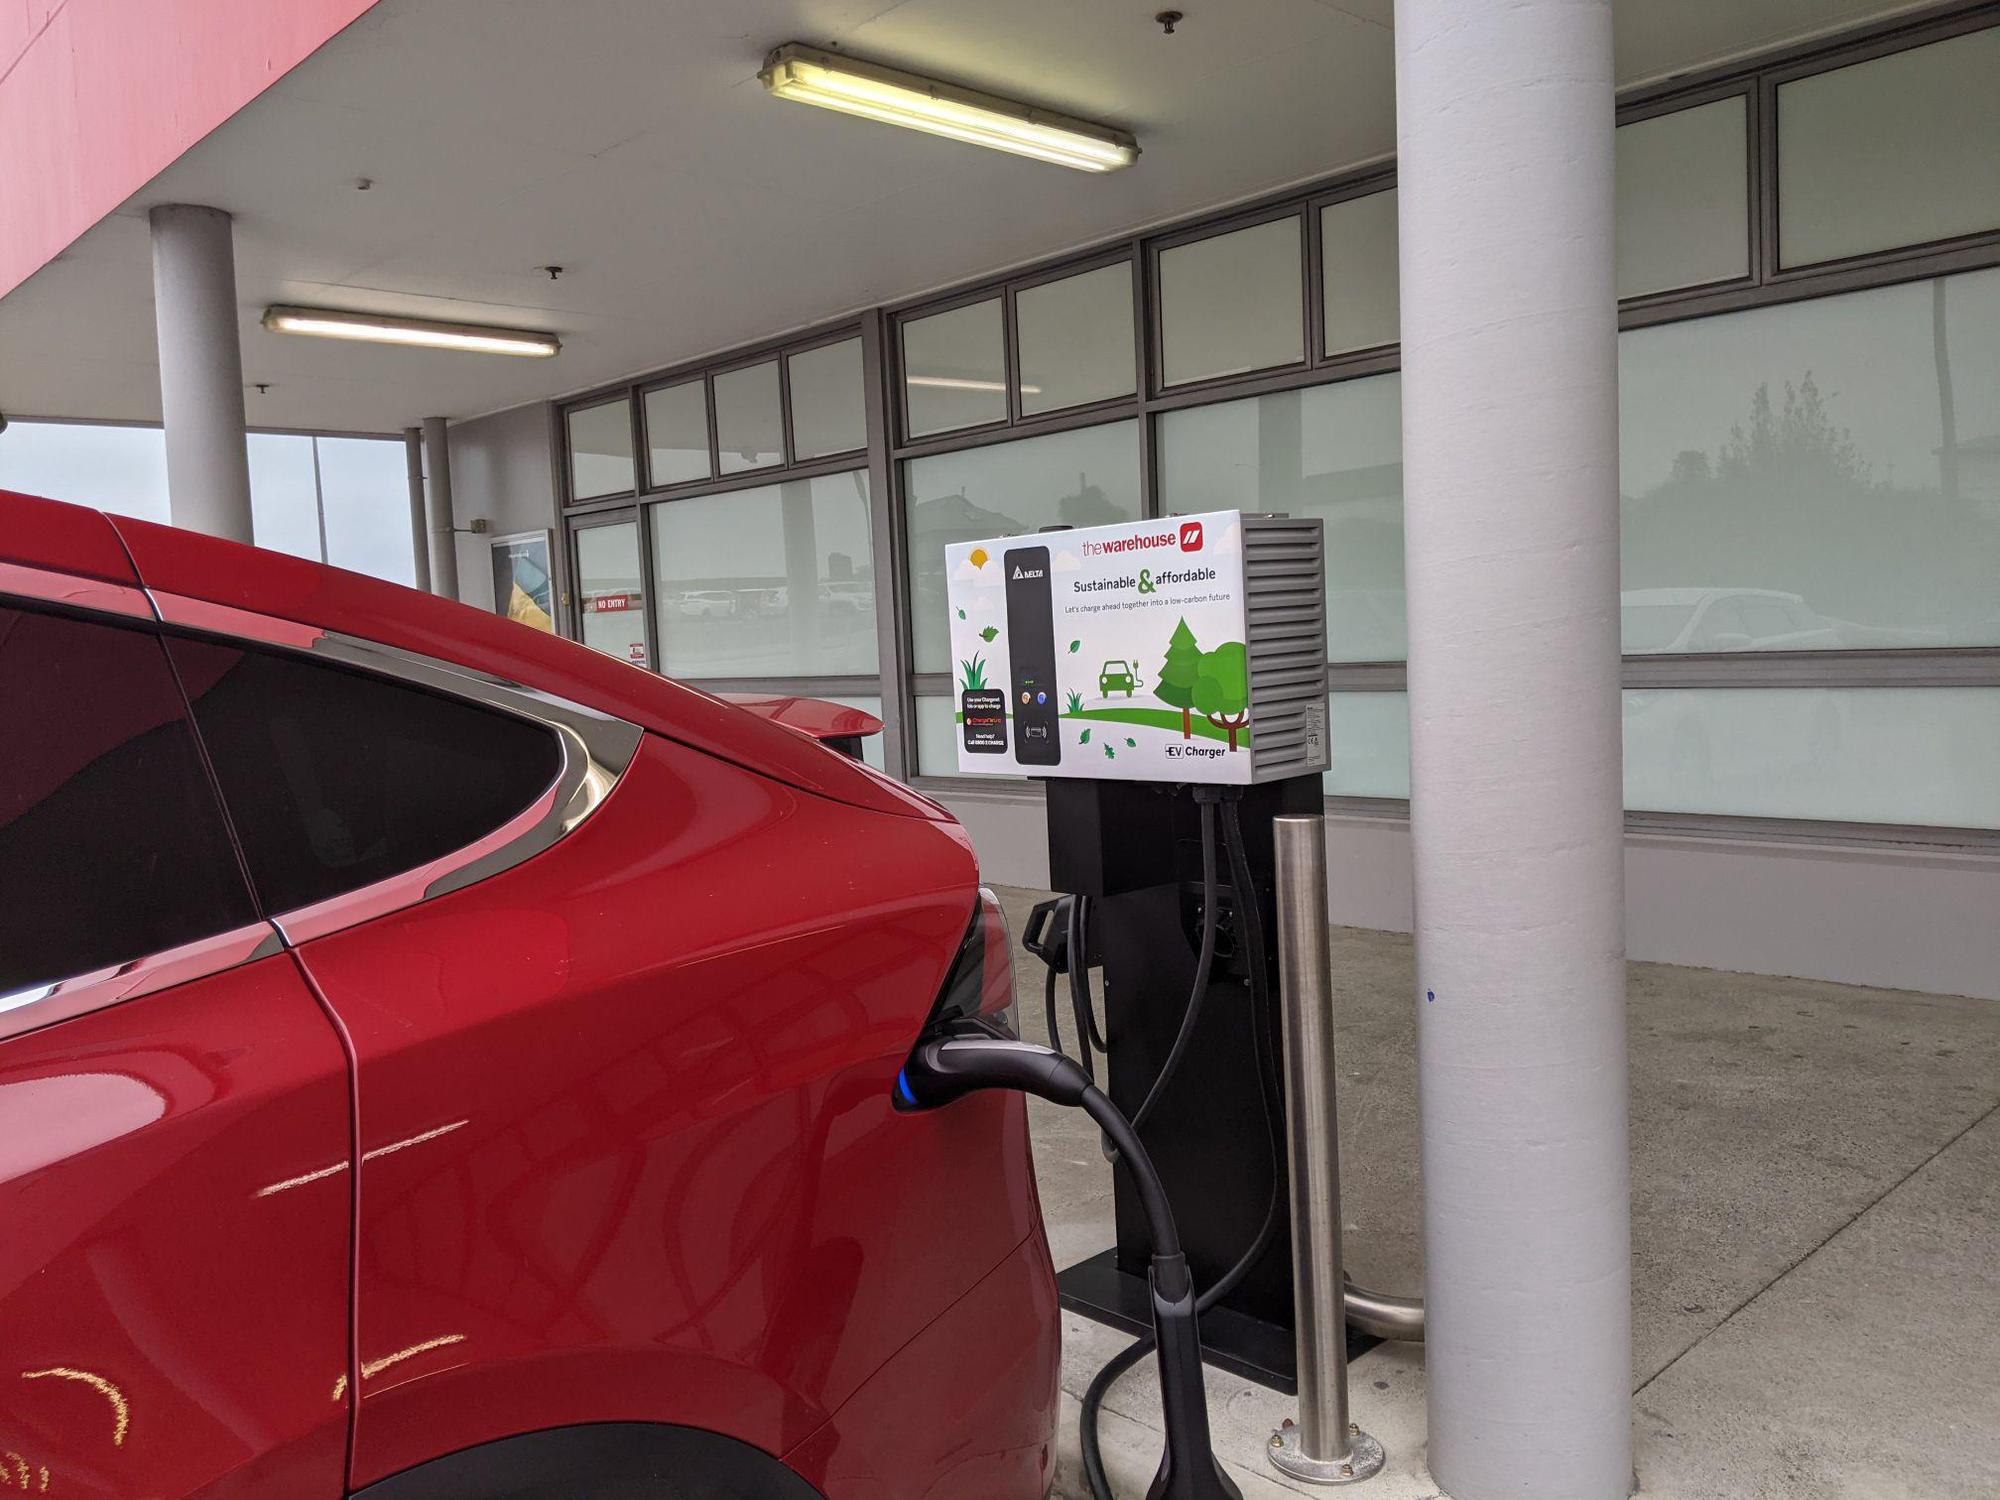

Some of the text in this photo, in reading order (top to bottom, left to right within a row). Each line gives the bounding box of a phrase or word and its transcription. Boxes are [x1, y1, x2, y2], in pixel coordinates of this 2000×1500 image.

[1025, 570, 1043, 578] DELTA
[1073, 567, 1216, 594] Sustainable & affordable
[597, 598, 626, 609] NO ENTRY
[1080, 605, 1100, 613] charge
[1102, 603, 1121, 611] ahead
[1122, 600, 1149, 610] together
[1170, 596, 1208, 604] low-carbon
[1208, 593, 1230, 601] future
[1167, 746, 1226, 759] EV Charger
